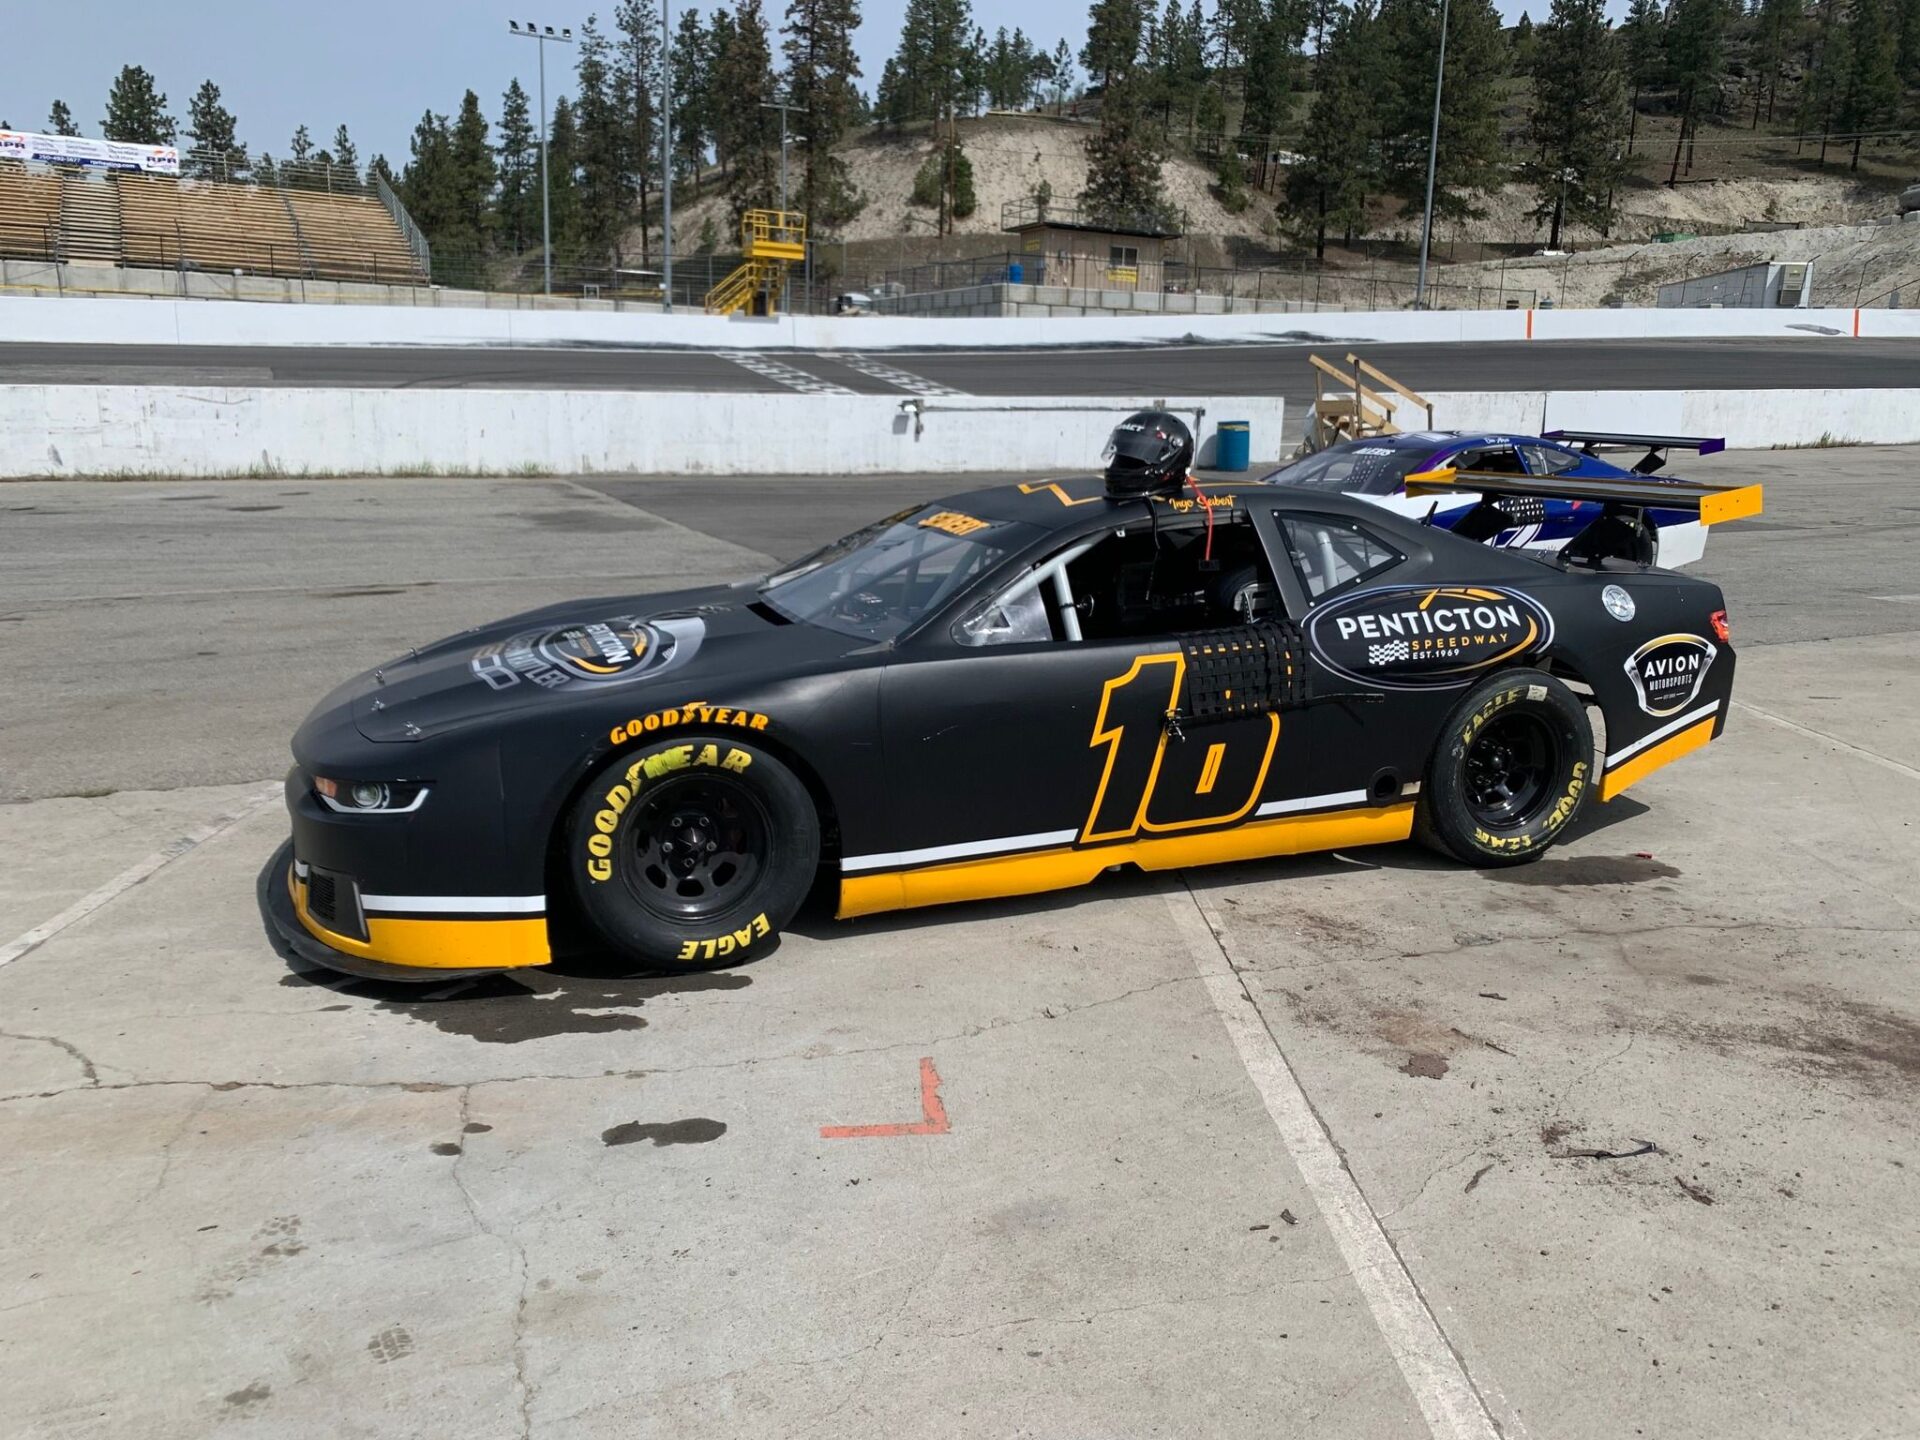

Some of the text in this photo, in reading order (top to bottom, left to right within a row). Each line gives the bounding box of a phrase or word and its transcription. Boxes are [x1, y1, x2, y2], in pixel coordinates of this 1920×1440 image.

[1168, 498, 1194, 513] Ingo
[1335, 605, 1521, 640] PENTICTON
[1411, 633, 1509, 651] SPEEDWAY
[1644, 654, 1699, 678] AVION
[1649, 674, 1692, 691] MOTORSPORTS
[609, 701, 769, 746] GOODYEAR
[588, 744, 752, 882] GOODEAR
[676, 912, 772, 961] EAGLE
